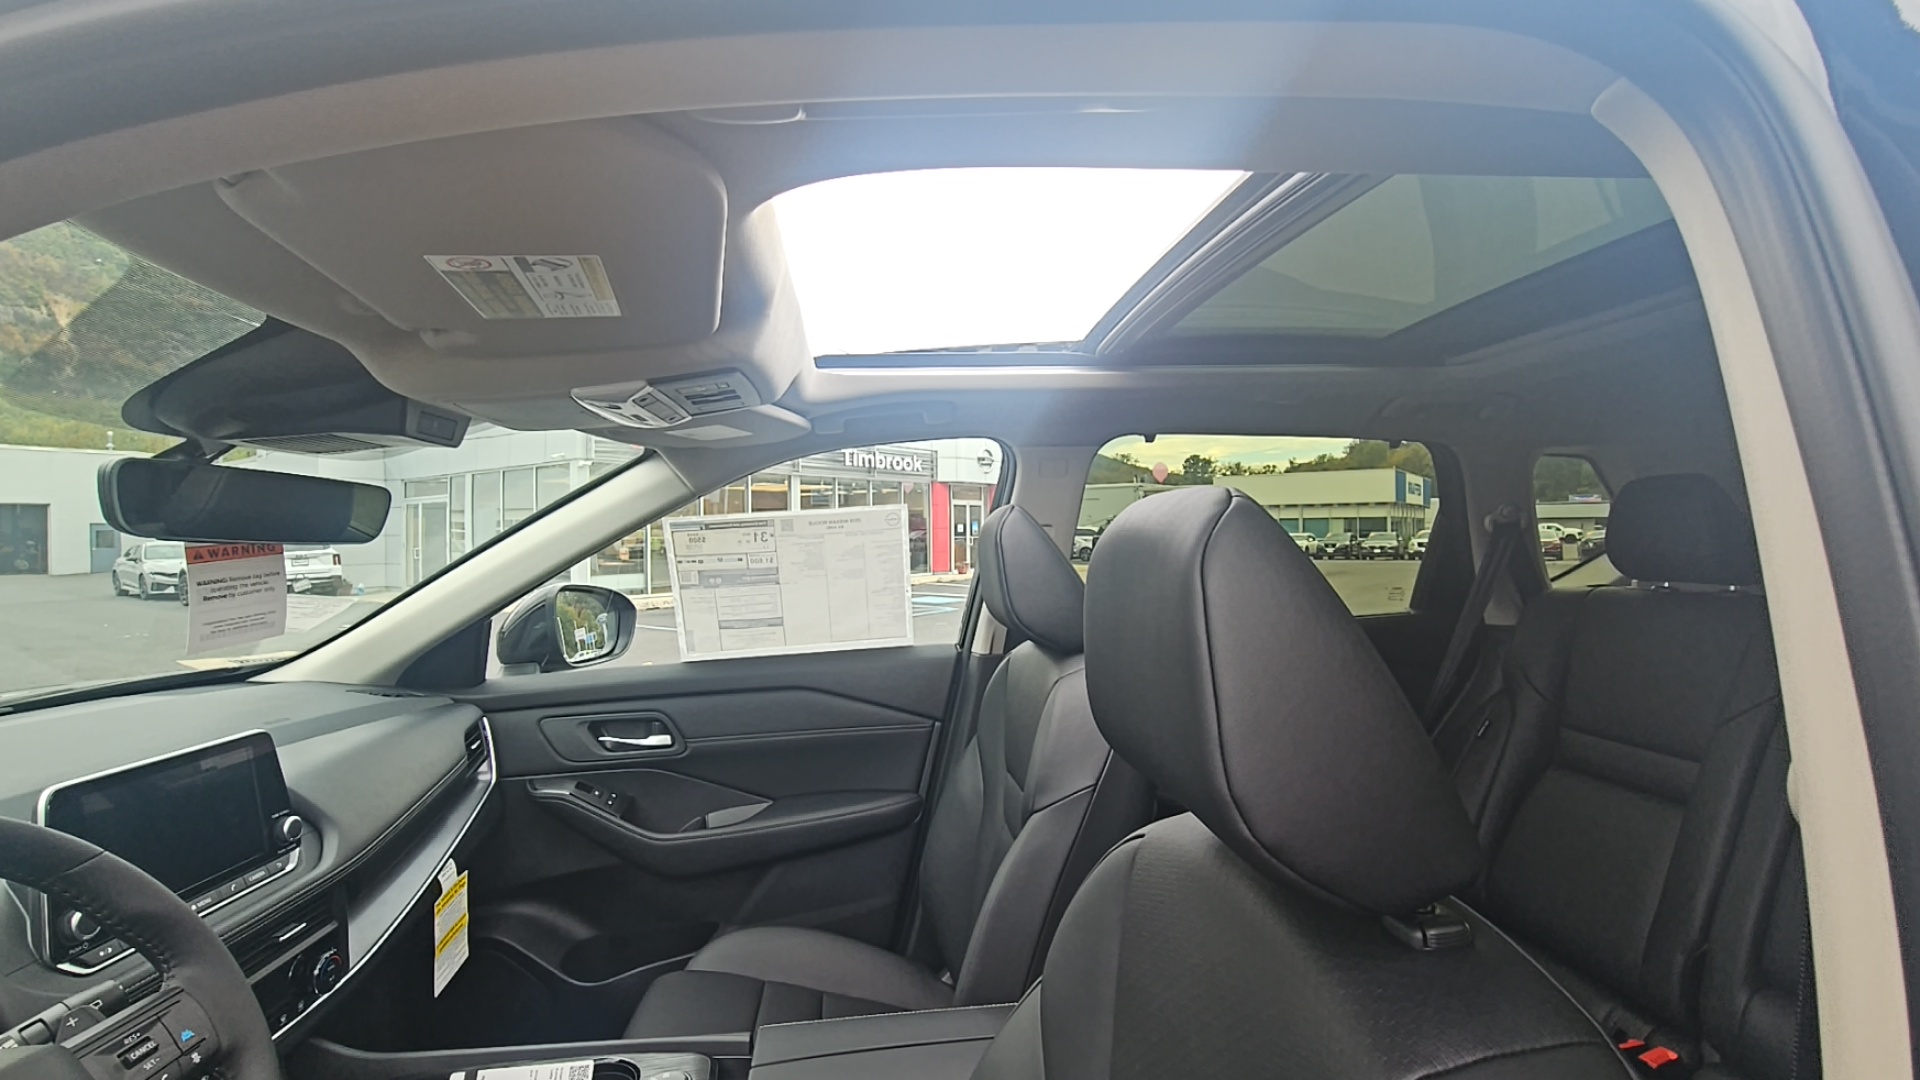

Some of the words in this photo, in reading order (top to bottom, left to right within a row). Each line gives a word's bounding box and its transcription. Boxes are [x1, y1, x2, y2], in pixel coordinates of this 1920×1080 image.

[841, 449, 923, 472] Timbrook
[207, 544, 276, 559] WARNING
[130, 1040, 157, 1060] CANCEL
